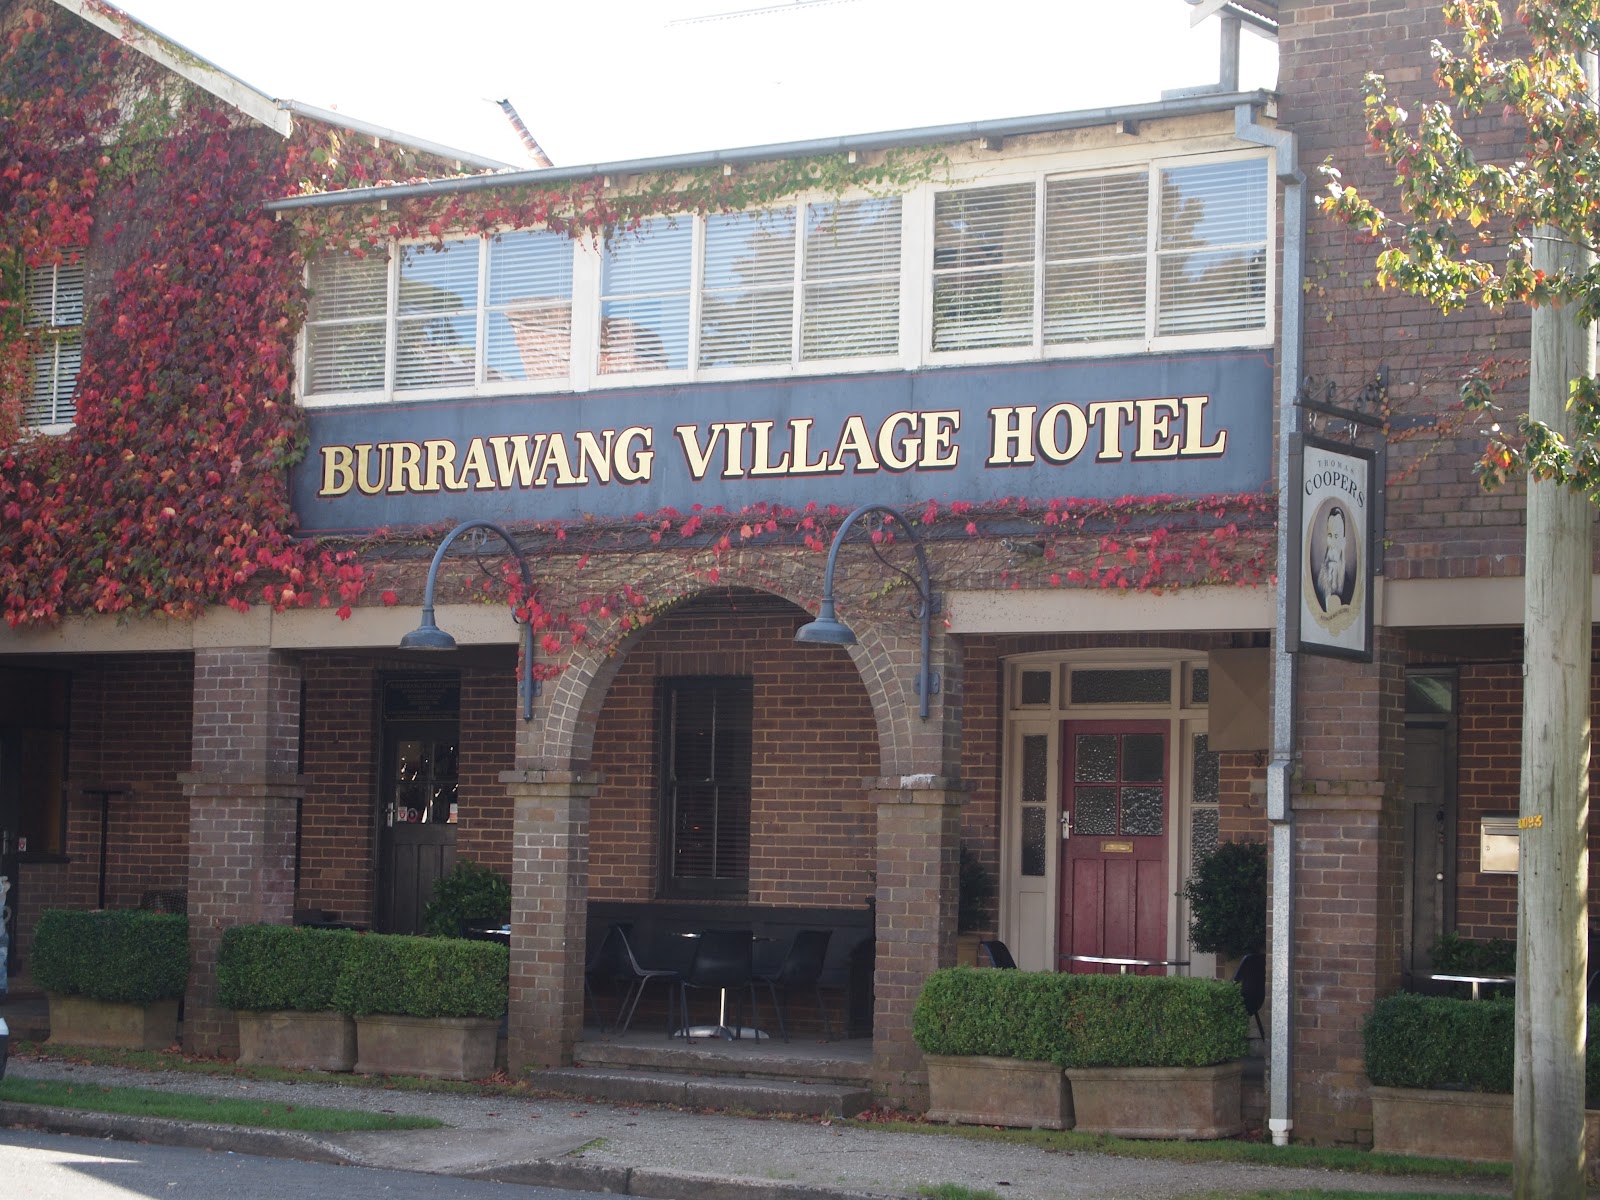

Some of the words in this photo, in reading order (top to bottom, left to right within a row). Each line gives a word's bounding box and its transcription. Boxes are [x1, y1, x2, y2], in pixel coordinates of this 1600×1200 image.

[318, 426, 654, 497] BURRAWANG
[676, 410, 960, 479] VILLAGE
[986, 397, 1227, 467] HOTEL
[1317, 459, 1355, 475] THOMAS
[1305, 470, 1365, 508] COOPERS
